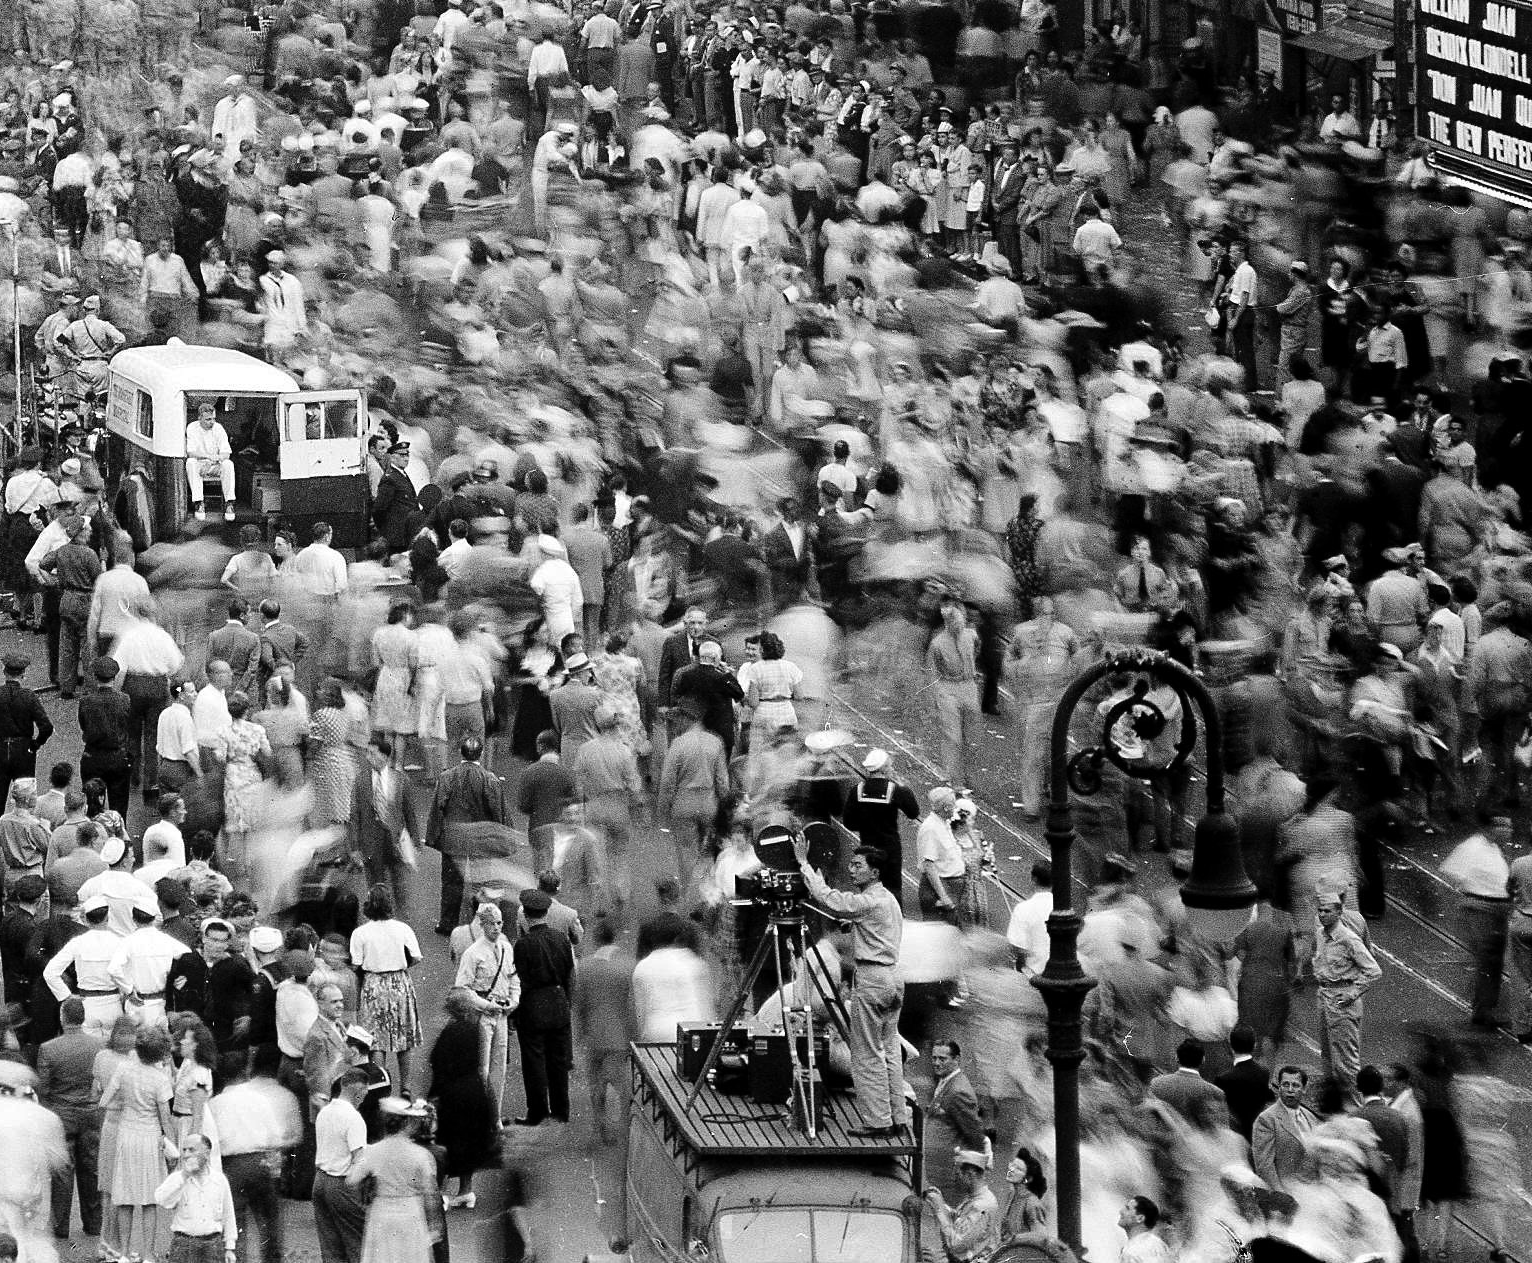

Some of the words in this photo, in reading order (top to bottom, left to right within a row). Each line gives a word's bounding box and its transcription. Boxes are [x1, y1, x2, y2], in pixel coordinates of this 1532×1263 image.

[1482, 1, 1516, 37] JOAN
[1468, 83, 1502, 119] JUAN
[1428, 110, 1451, 146] THE
